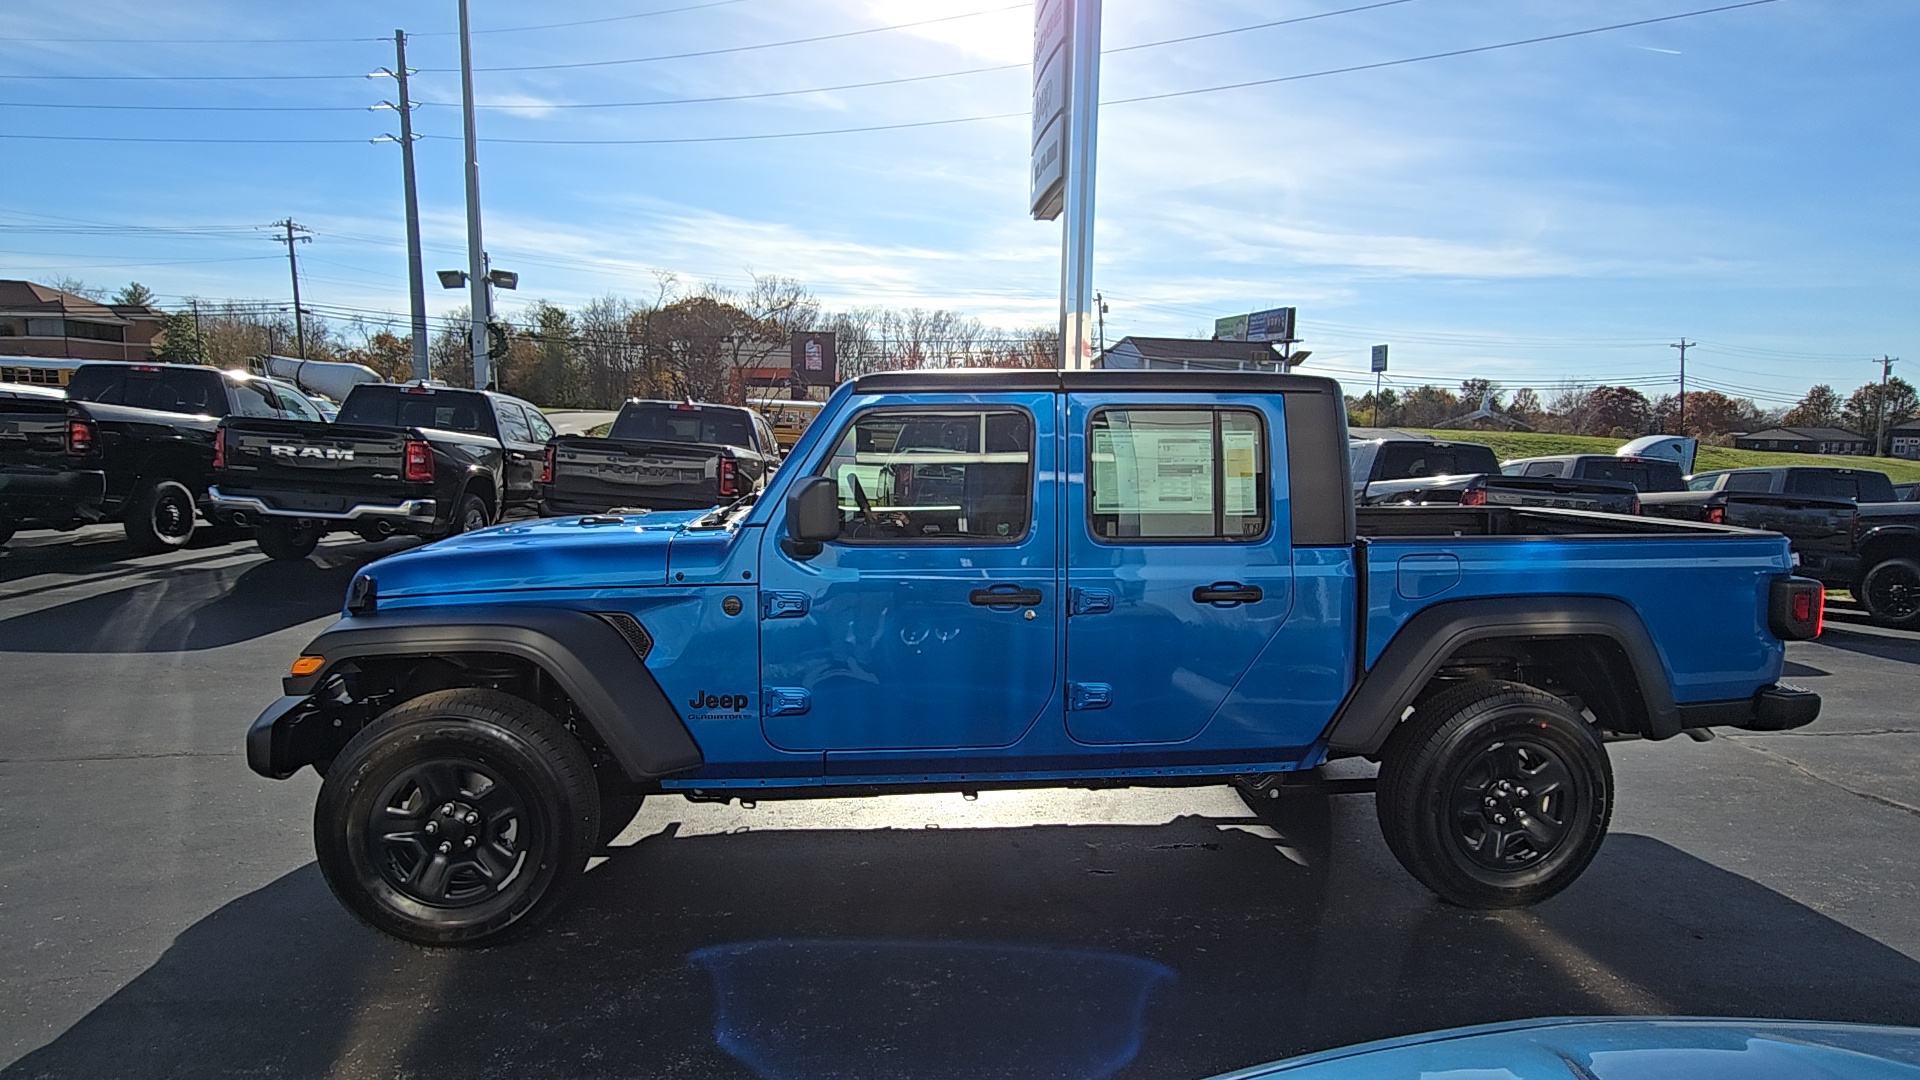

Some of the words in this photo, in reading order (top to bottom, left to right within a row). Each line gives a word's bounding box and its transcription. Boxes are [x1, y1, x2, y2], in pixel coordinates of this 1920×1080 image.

[270, 444, 355, 461] RAM
[597, 463, 674, 478] RAM
[689, 690, 748, 712] Jeep
